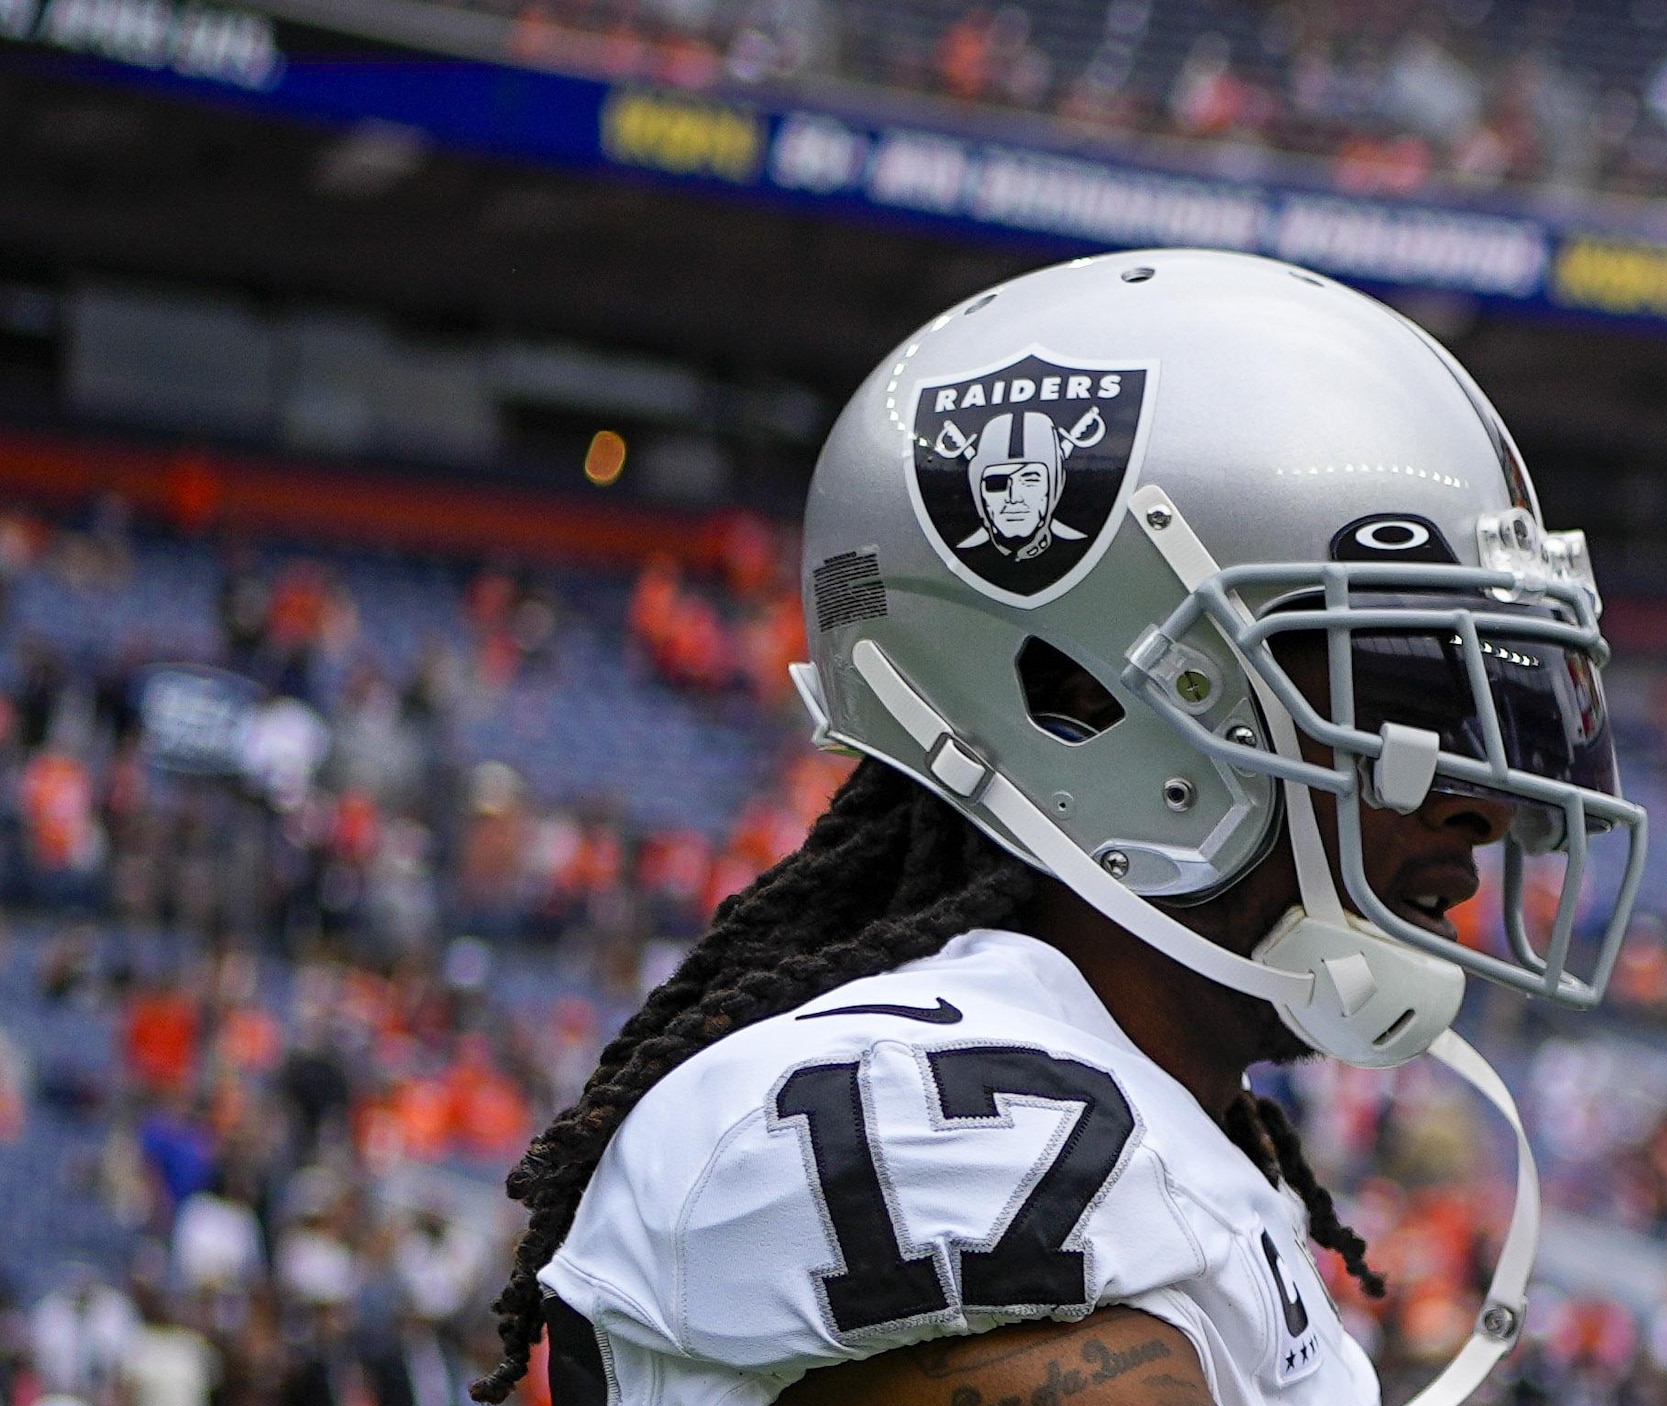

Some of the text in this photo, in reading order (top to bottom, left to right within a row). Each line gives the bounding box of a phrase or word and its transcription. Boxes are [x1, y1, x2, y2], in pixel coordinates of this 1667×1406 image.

[934, 373, 1122, 413] RAIDERS
[768, 1042, 1143, 1338] 17
[1260, 1226, 1309, 1339] C
